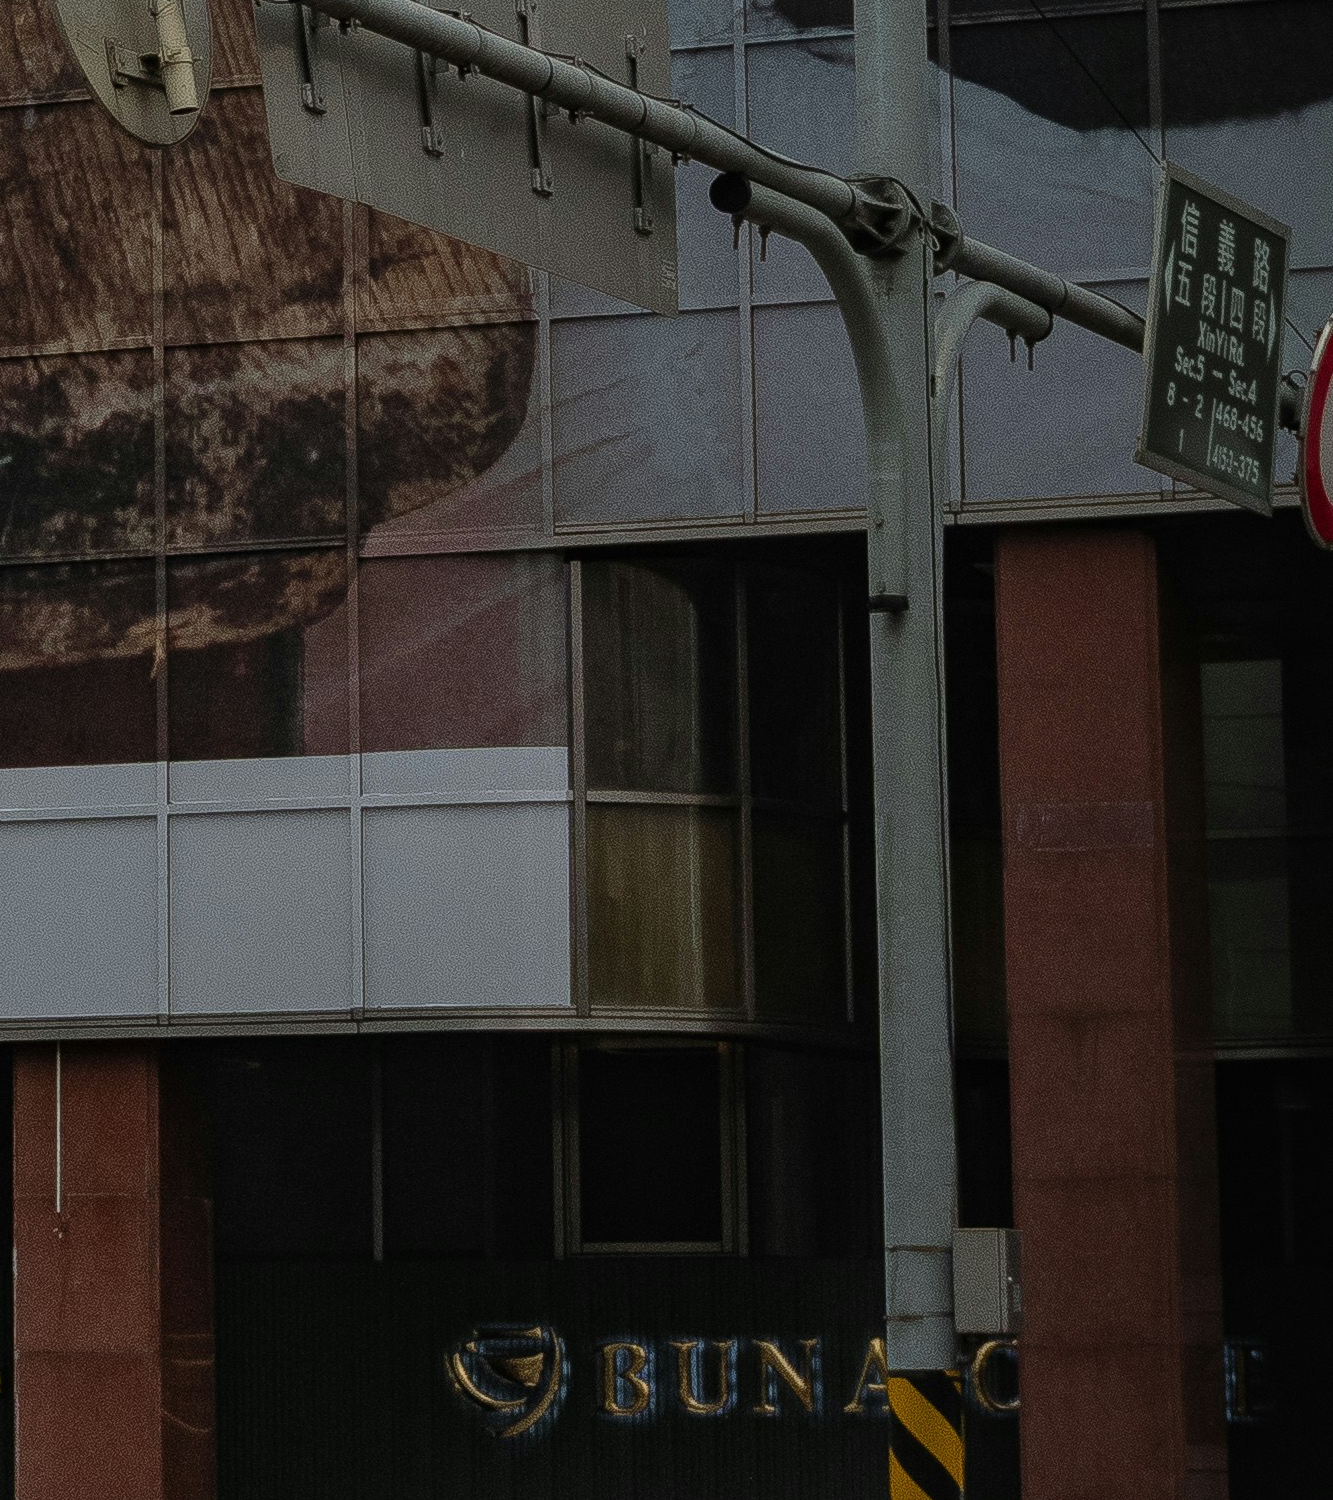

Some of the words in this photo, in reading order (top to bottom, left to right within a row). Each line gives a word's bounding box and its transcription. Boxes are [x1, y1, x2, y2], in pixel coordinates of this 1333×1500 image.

[1180, 199, 1271, 294] 信義路
[1175, 260, 1217, 319] 五段
[1229, 286, 1267, 344] 四段
[1194, 394, 1204, 419] 2
[1215, 401, 1264, 443] 468-456
